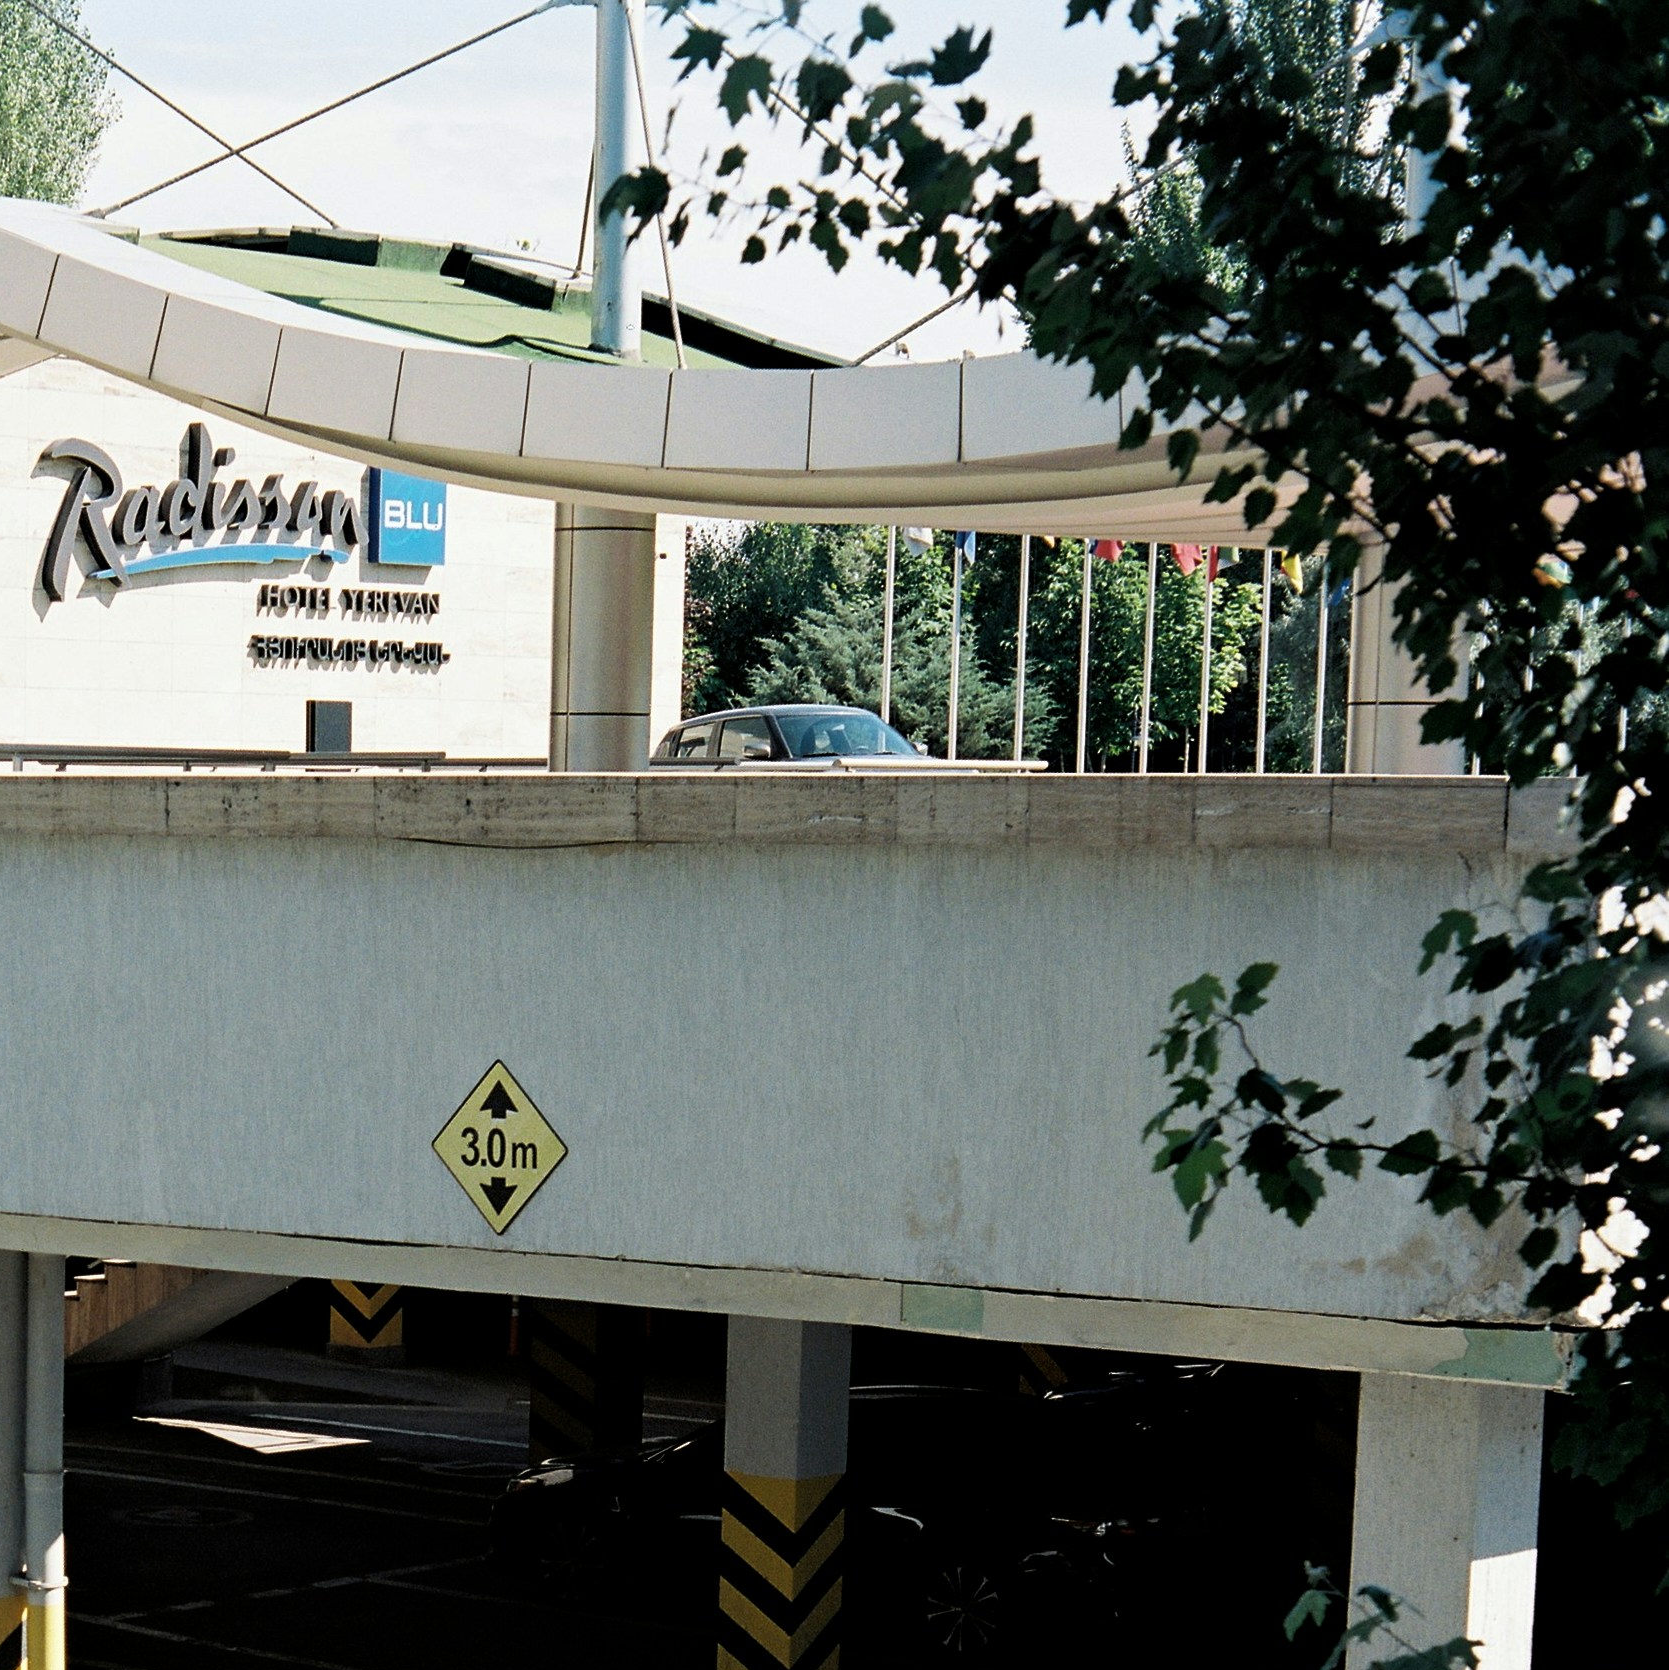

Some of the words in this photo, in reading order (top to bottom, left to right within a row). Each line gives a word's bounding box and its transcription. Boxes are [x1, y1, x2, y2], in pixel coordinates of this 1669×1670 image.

[38, 422, 369, 602] Radisson
[385, 500, 444, 531] BLU
[342, 589, 440, 616] YEREVAN
